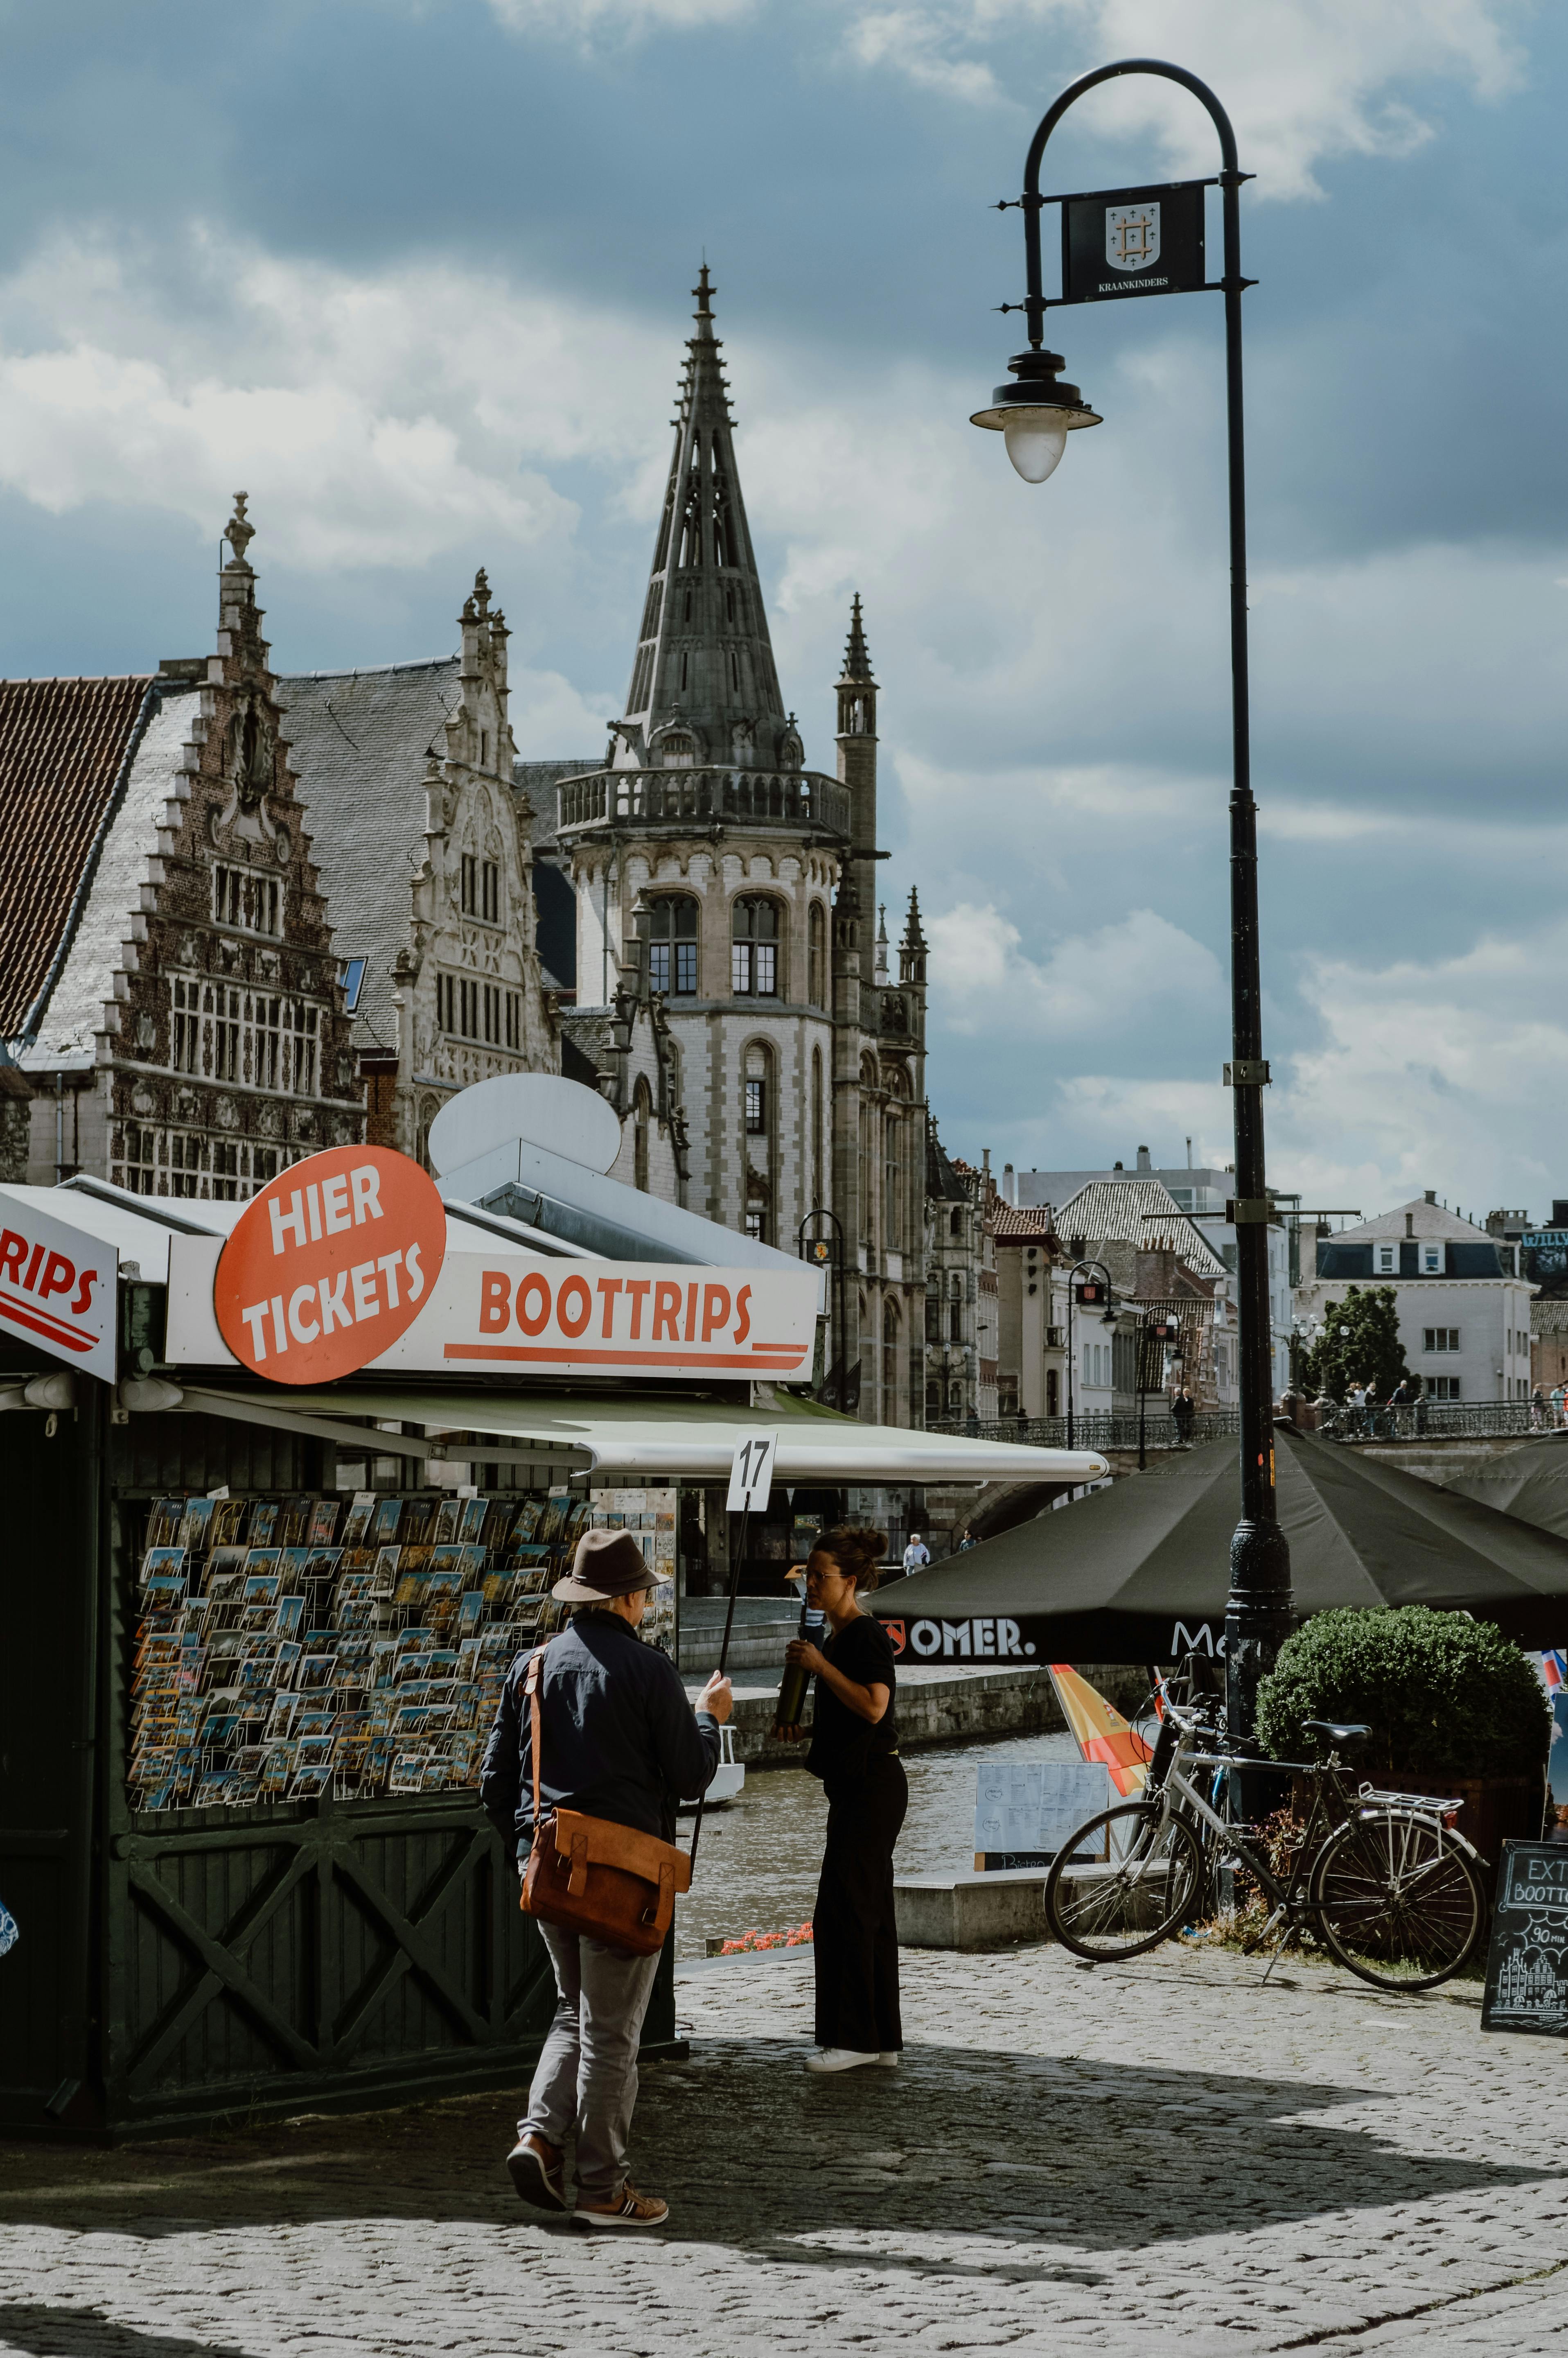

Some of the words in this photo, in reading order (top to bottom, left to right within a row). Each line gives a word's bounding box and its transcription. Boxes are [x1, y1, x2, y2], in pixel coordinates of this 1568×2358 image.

[1099, 277, 1168, 292] KRAANKINDERS
[268, 1165, 384, 1255] HIER
[242, 1242, 424, 1362] TICKETS
[479, 1271, 752, 1345] BOOTTRIPS
[739, 1441, 769, 1487] 17
[910, 1619, 1036, 1656] OMER.
[1531, 1927, 1550, 1943] 90
